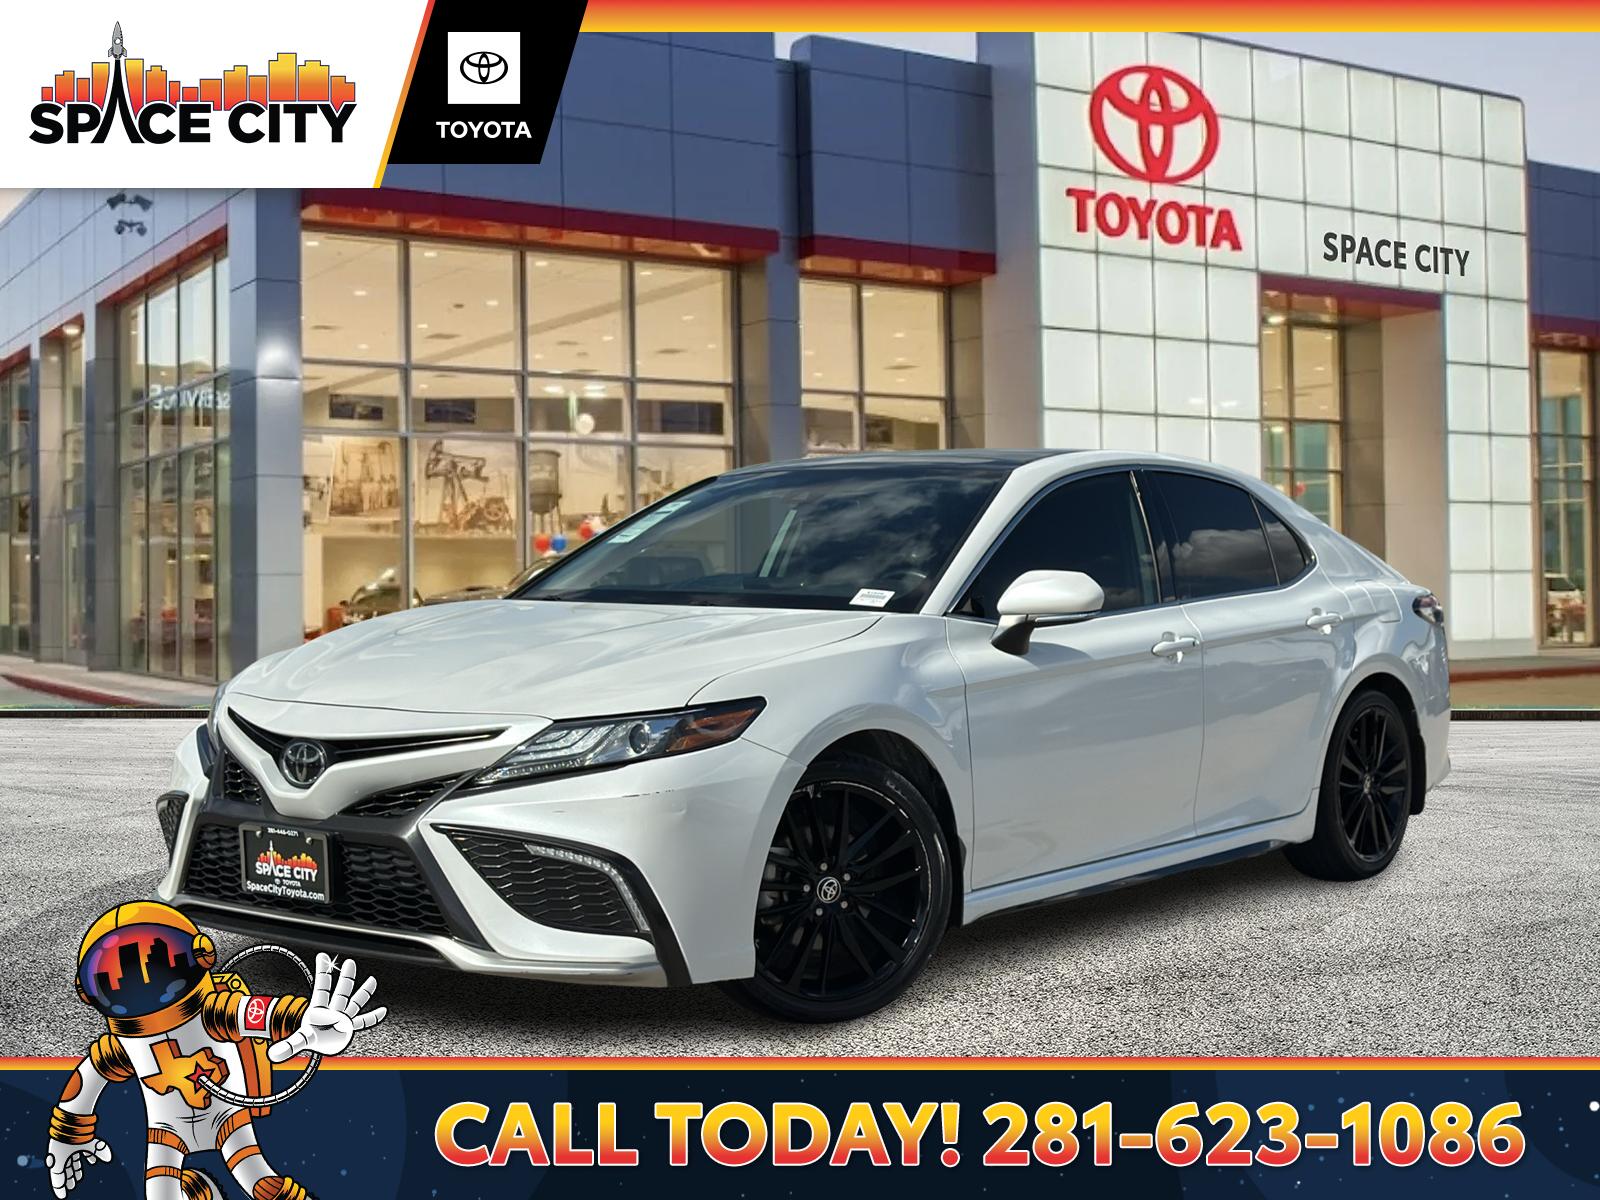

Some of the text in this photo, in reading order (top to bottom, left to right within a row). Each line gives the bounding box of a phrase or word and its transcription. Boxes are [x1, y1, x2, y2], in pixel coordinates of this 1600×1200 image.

[1066, 188, 1243, 251] TOYOTA
[1323, 232, 1470, 277] SPACE CITY
[255, 858, 318, 882] SPACE CITY
[246, 880, 325, 901] SpaceCityToyota.com
[282, 879, 302, 887] TOYOTA
